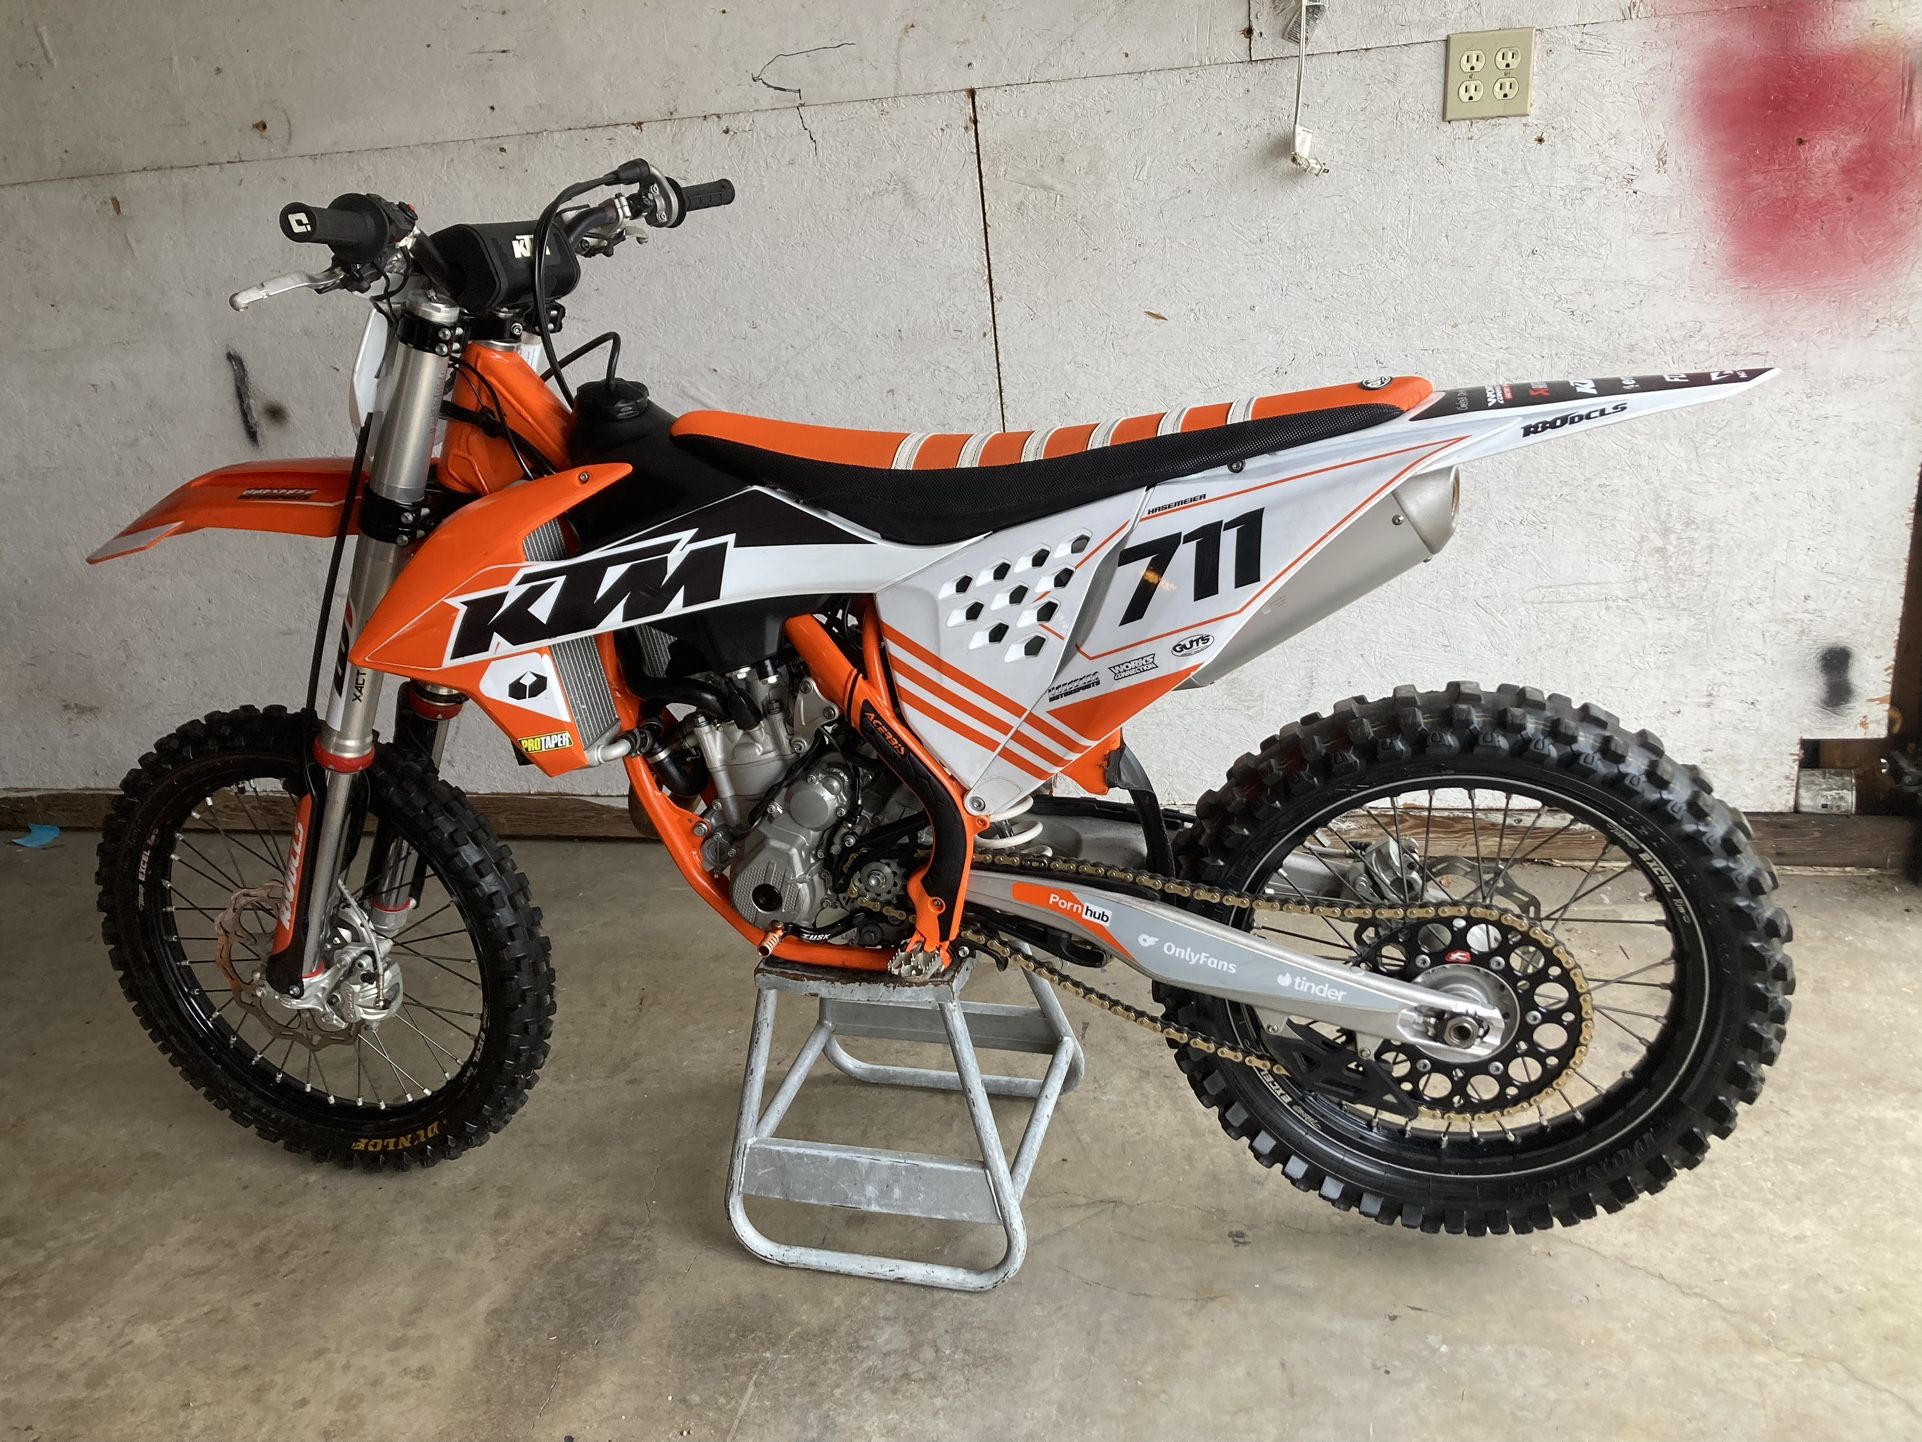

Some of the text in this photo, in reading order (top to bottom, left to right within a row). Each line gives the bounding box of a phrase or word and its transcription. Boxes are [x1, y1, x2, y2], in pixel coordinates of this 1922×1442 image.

[512, 234, 551, 259] KT
[1147, 493, 1207, 515] HASEMEIER
[1118, 507, 1265, 627] 711
[450, 540, 729, 660] KTM
[1172, 634, 1211, 653] GUTS
[1109, 653, 1156, 674] WORKS
[1114, 663, 1158, 681] CONNECTION
[352, 669, 367, 703] XACT
[521, 733, 570, 752] PROTAPER
[865, 712, 905, 756] ACERBIS
[1639, 851, 1675, 893] EXCEL
[802, 933, 831, 941] TUSK
[1164, 941, 1237, 975] OnlyFans
[1294, 975, 1348, 1002] tinder
[1260, 1069, 1293, 1104] EXCEL
